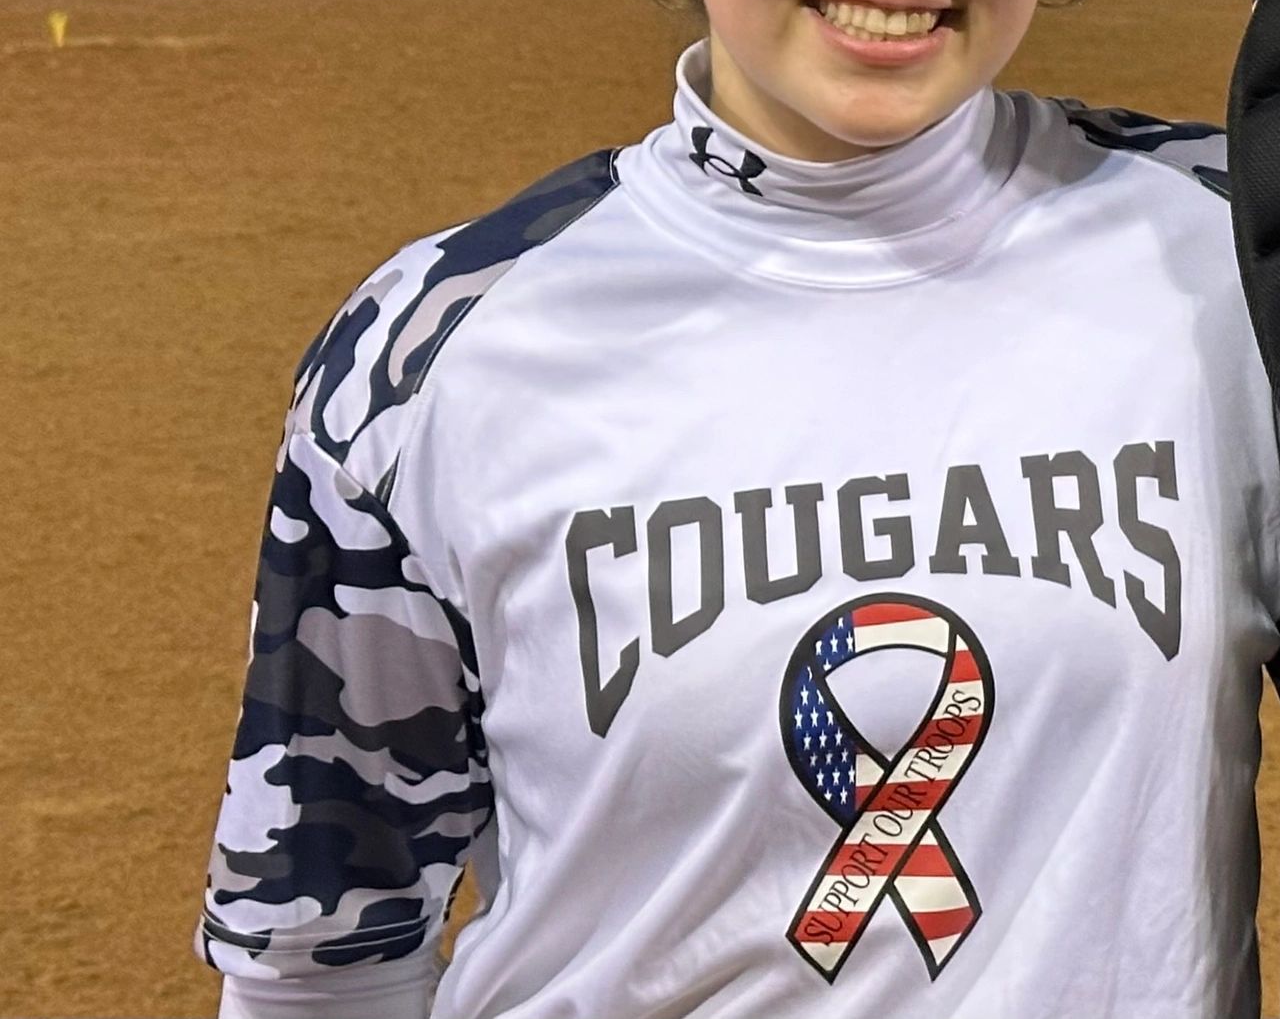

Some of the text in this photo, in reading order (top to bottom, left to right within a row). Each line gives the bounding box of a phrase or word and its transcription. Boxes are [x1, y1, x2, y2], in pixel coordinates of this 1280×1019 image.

[565, 440, 1182, 739] COUGARS
[804, 689, 982, 946] SUPPORT OUR TROOPS
